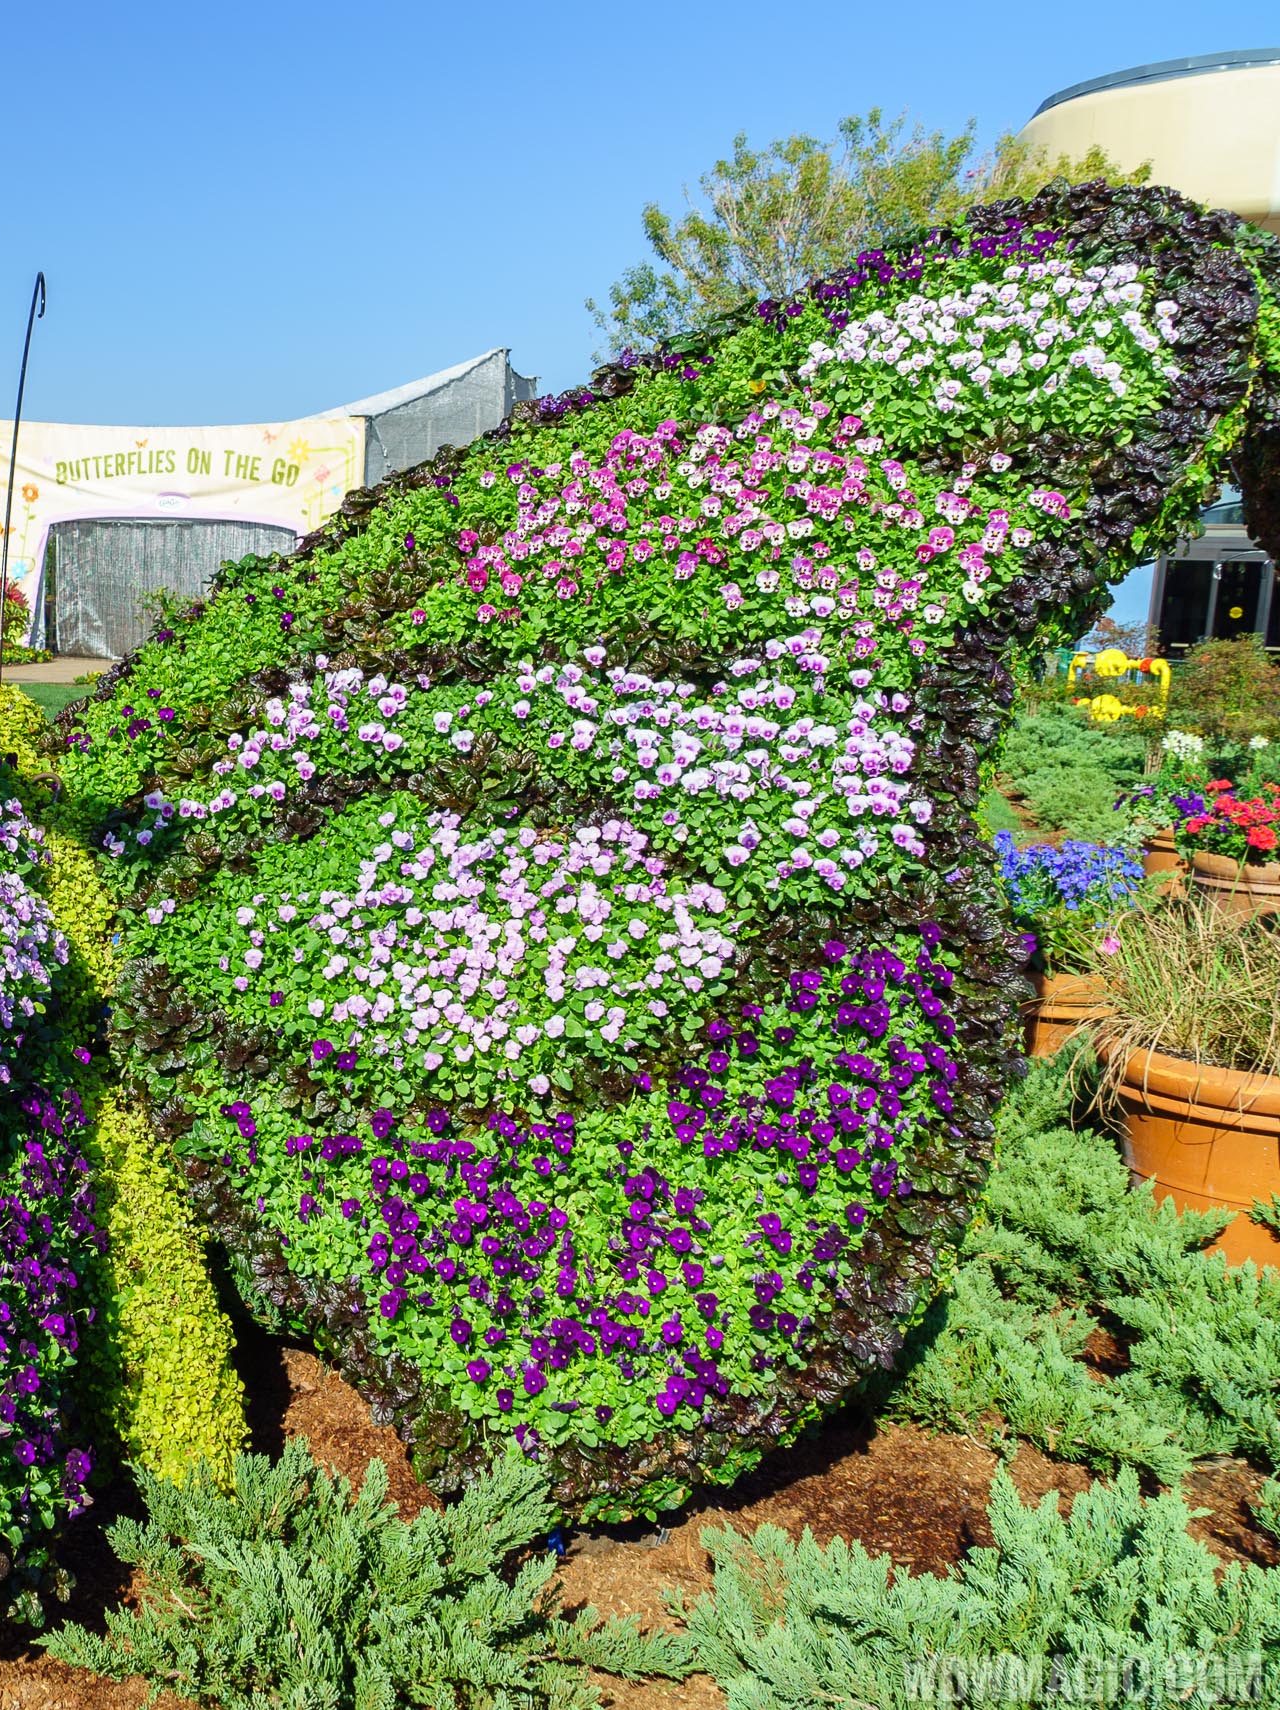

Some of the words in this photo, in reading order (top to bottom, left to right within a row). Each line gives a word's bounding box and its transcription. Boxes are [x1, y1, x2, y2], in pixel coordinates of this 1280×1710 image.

[56, 449, 176, 485] BUTTERFLIES
[187, 447, 211, 475] ON
[224, 450, 261, 481] THE
[272, 458, 300, 487] GO
